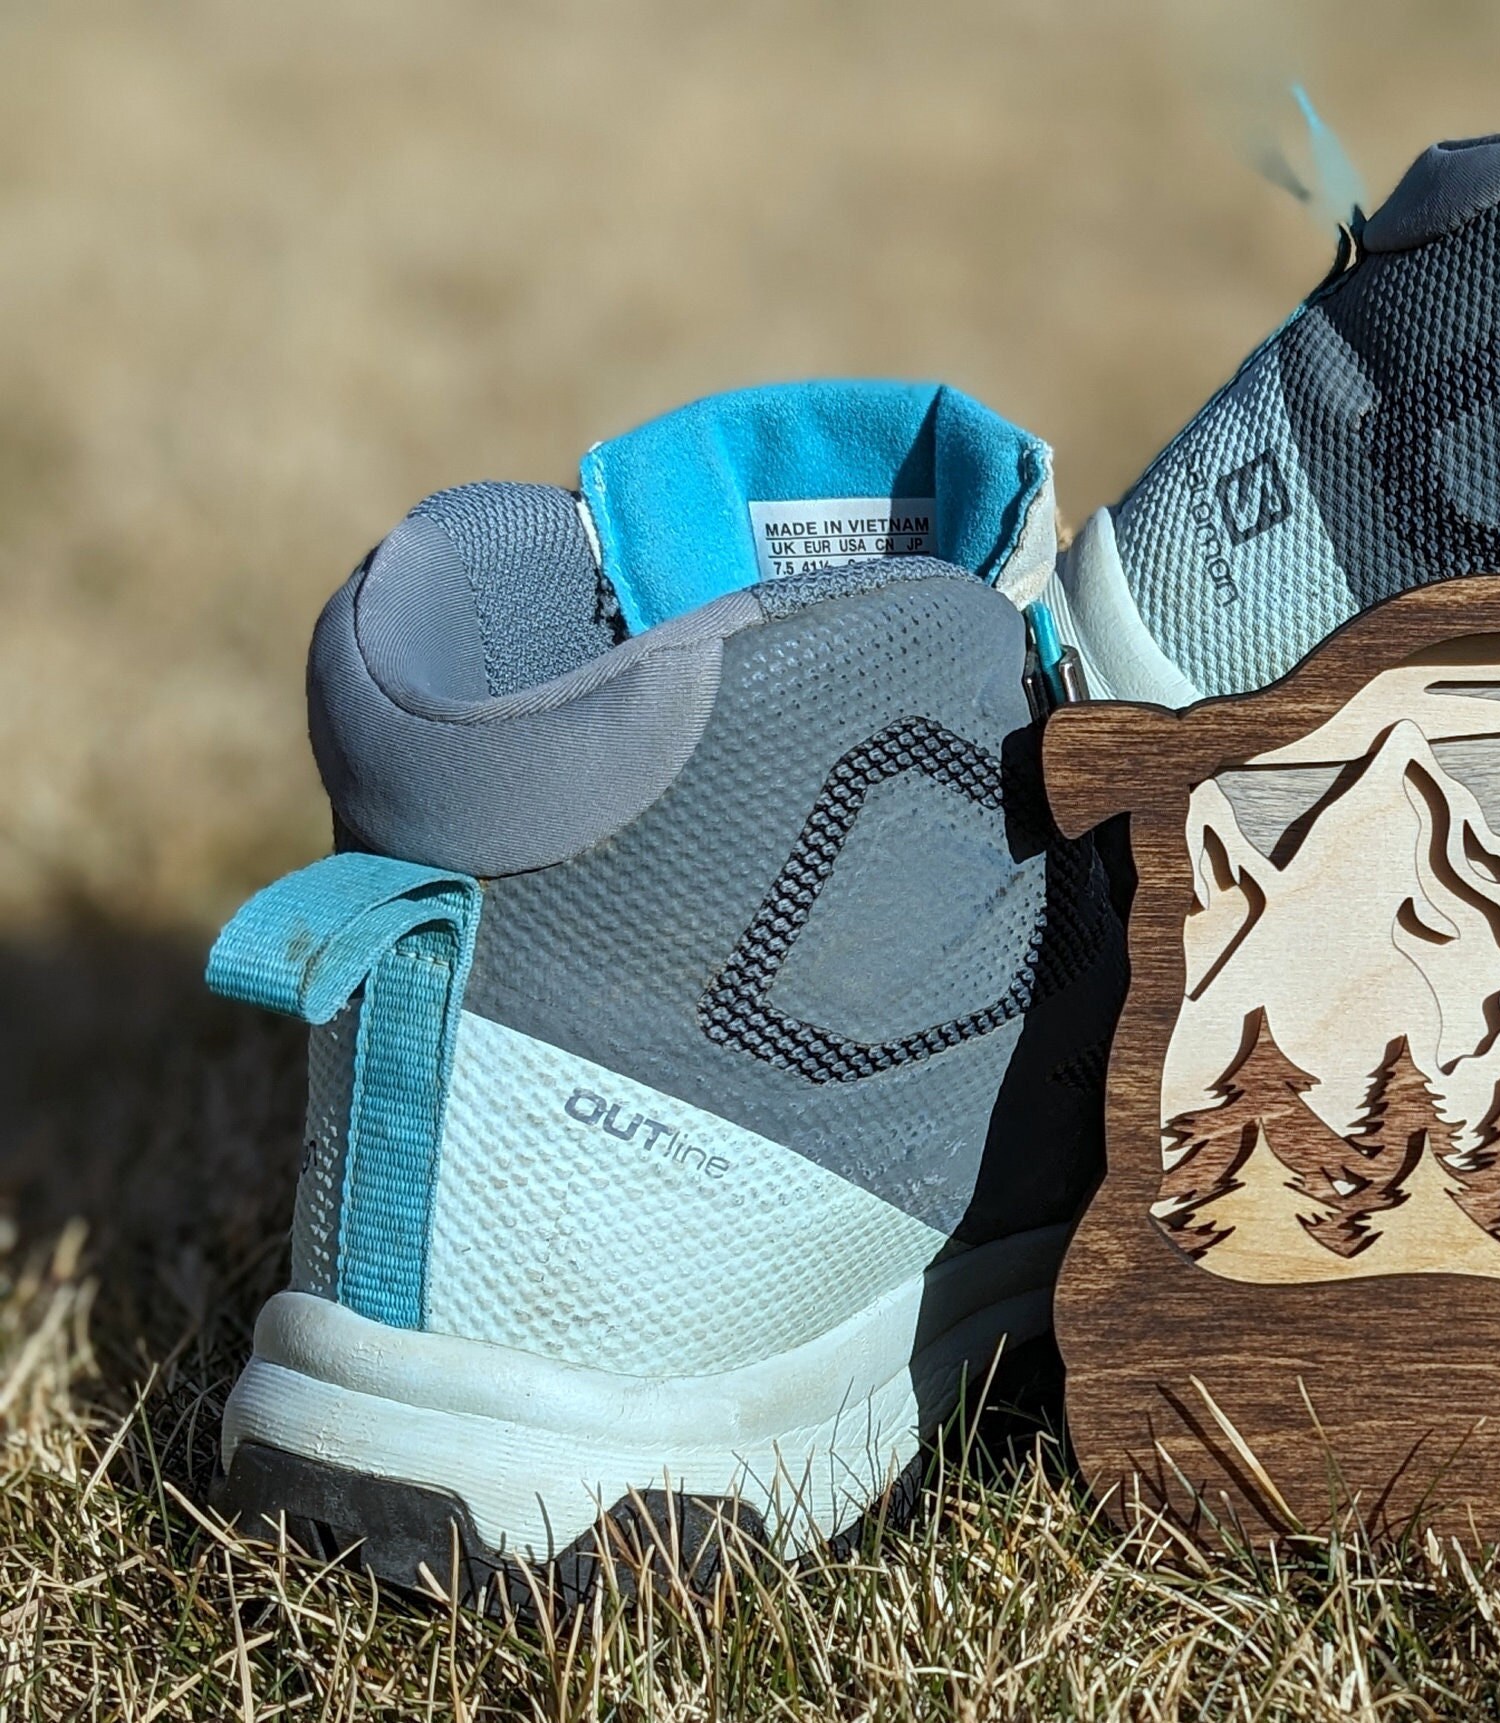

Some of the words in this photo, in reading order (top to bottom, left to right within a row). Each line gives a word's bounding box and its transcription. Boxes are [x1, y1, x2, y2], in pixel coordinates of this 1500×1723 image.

[765, 523, 818, 536] MADE
[824, 520, 842, 535] IN
[848, 517, 929, 533] VIETNAM
[771, 542, 796, 555] UK
[804, 540, 831, 553] EUR
[839, 539, 866, 552] USA
[875, 537, 895, 551] CN
[906, 537, 923, 551] JP
[773, 561, 794, 575] 7.5
[564, 1087, 730, 1179] OUTline
